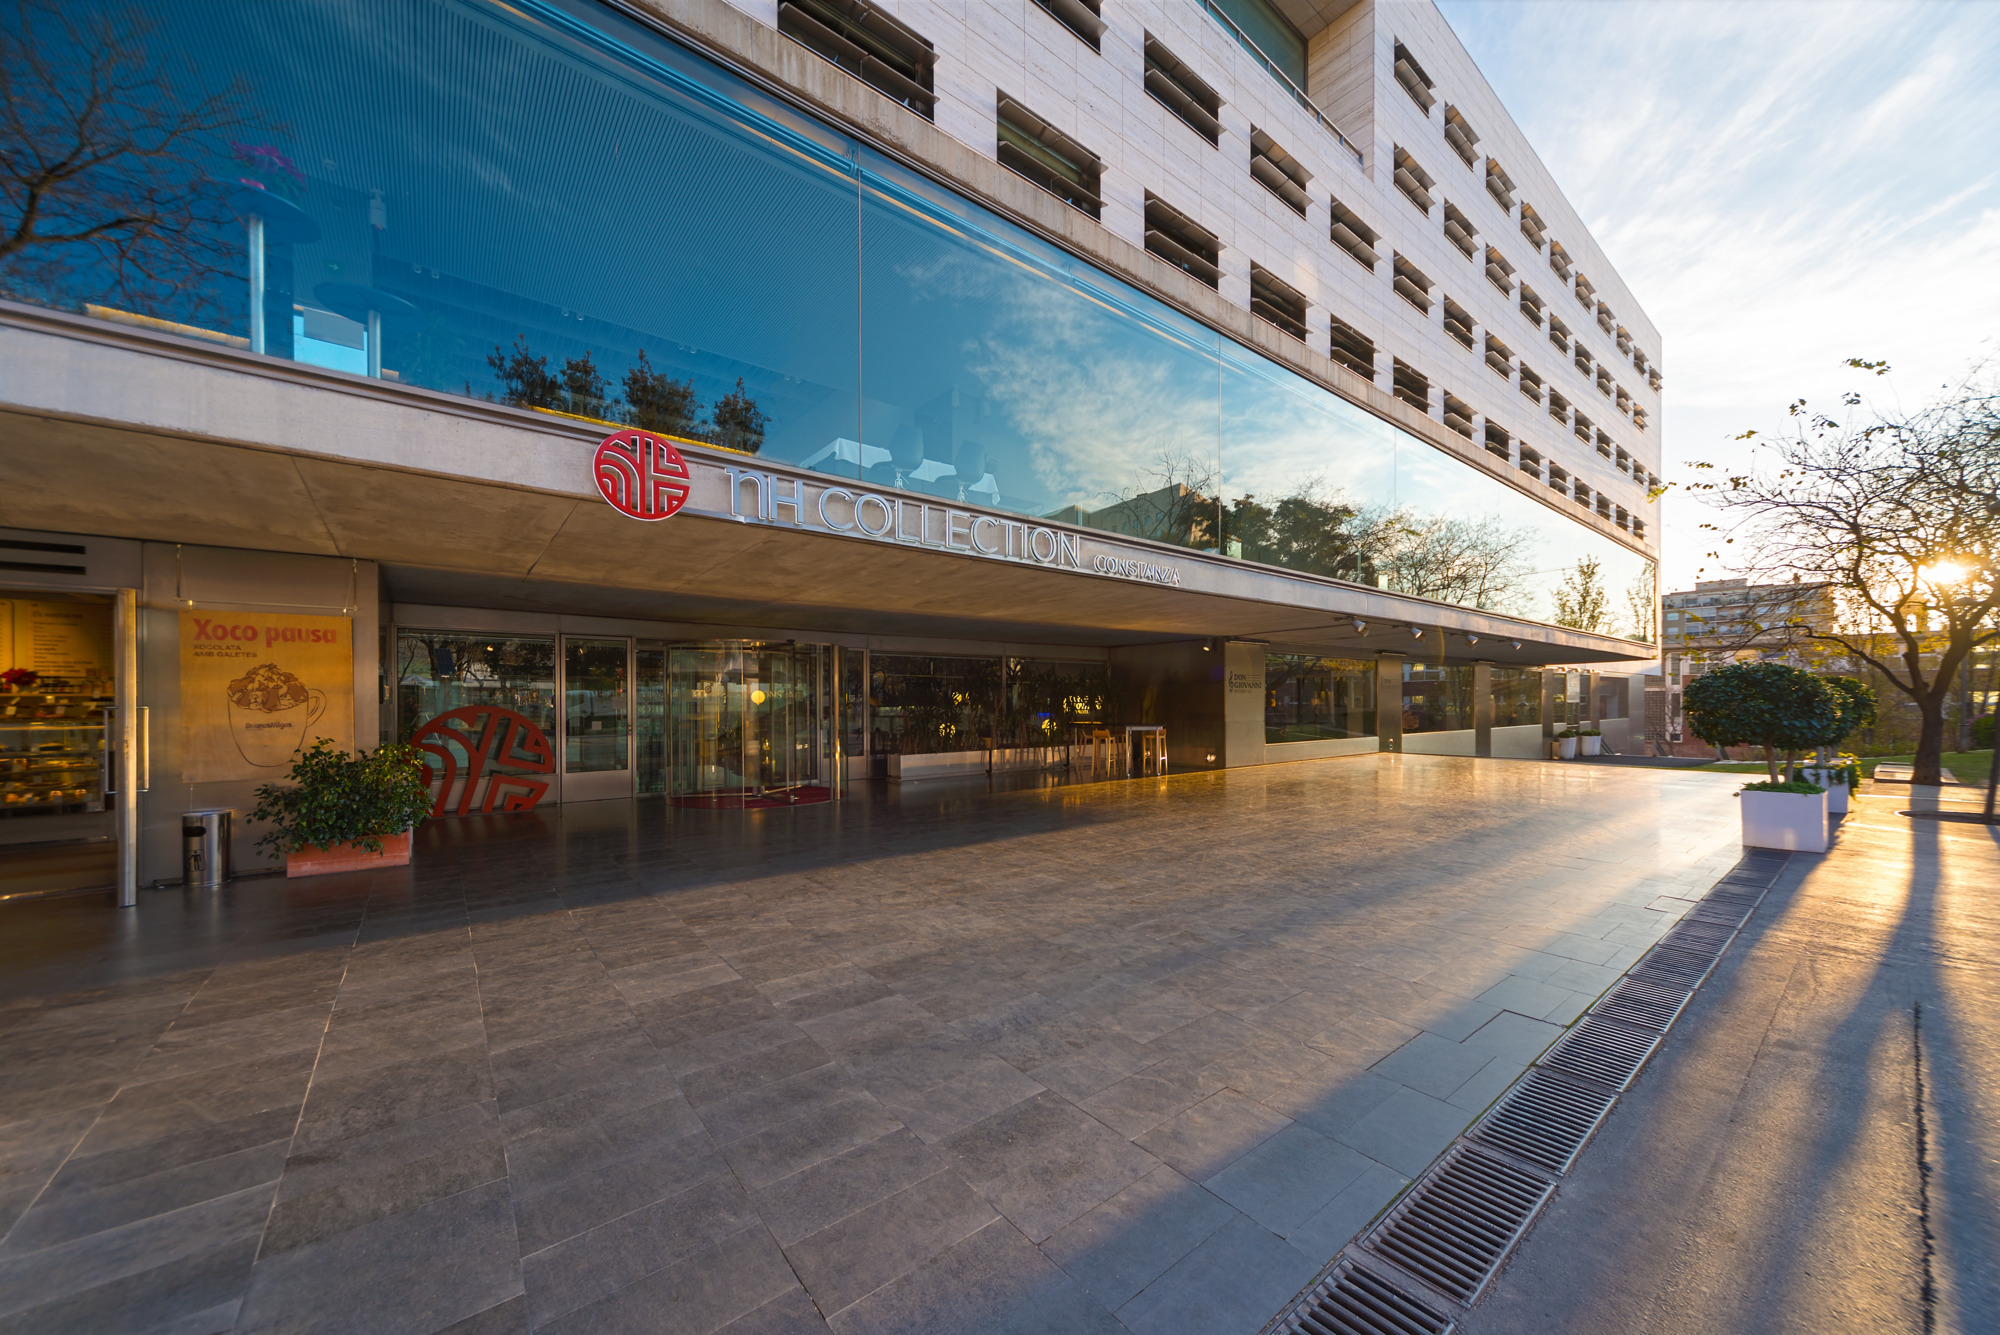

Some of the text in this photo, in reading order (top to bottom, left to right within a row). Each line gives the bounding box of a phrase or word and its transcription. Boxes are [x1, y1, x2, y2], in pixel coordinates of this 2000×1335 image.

[817, 486, 1080, 568] COLLECTION
[1093, 554, 1180, 584] CONSTANZA
[193, 618, 337, 648] Xoco pausa
[1234, 681, 1262, 689] GIOVANNI
